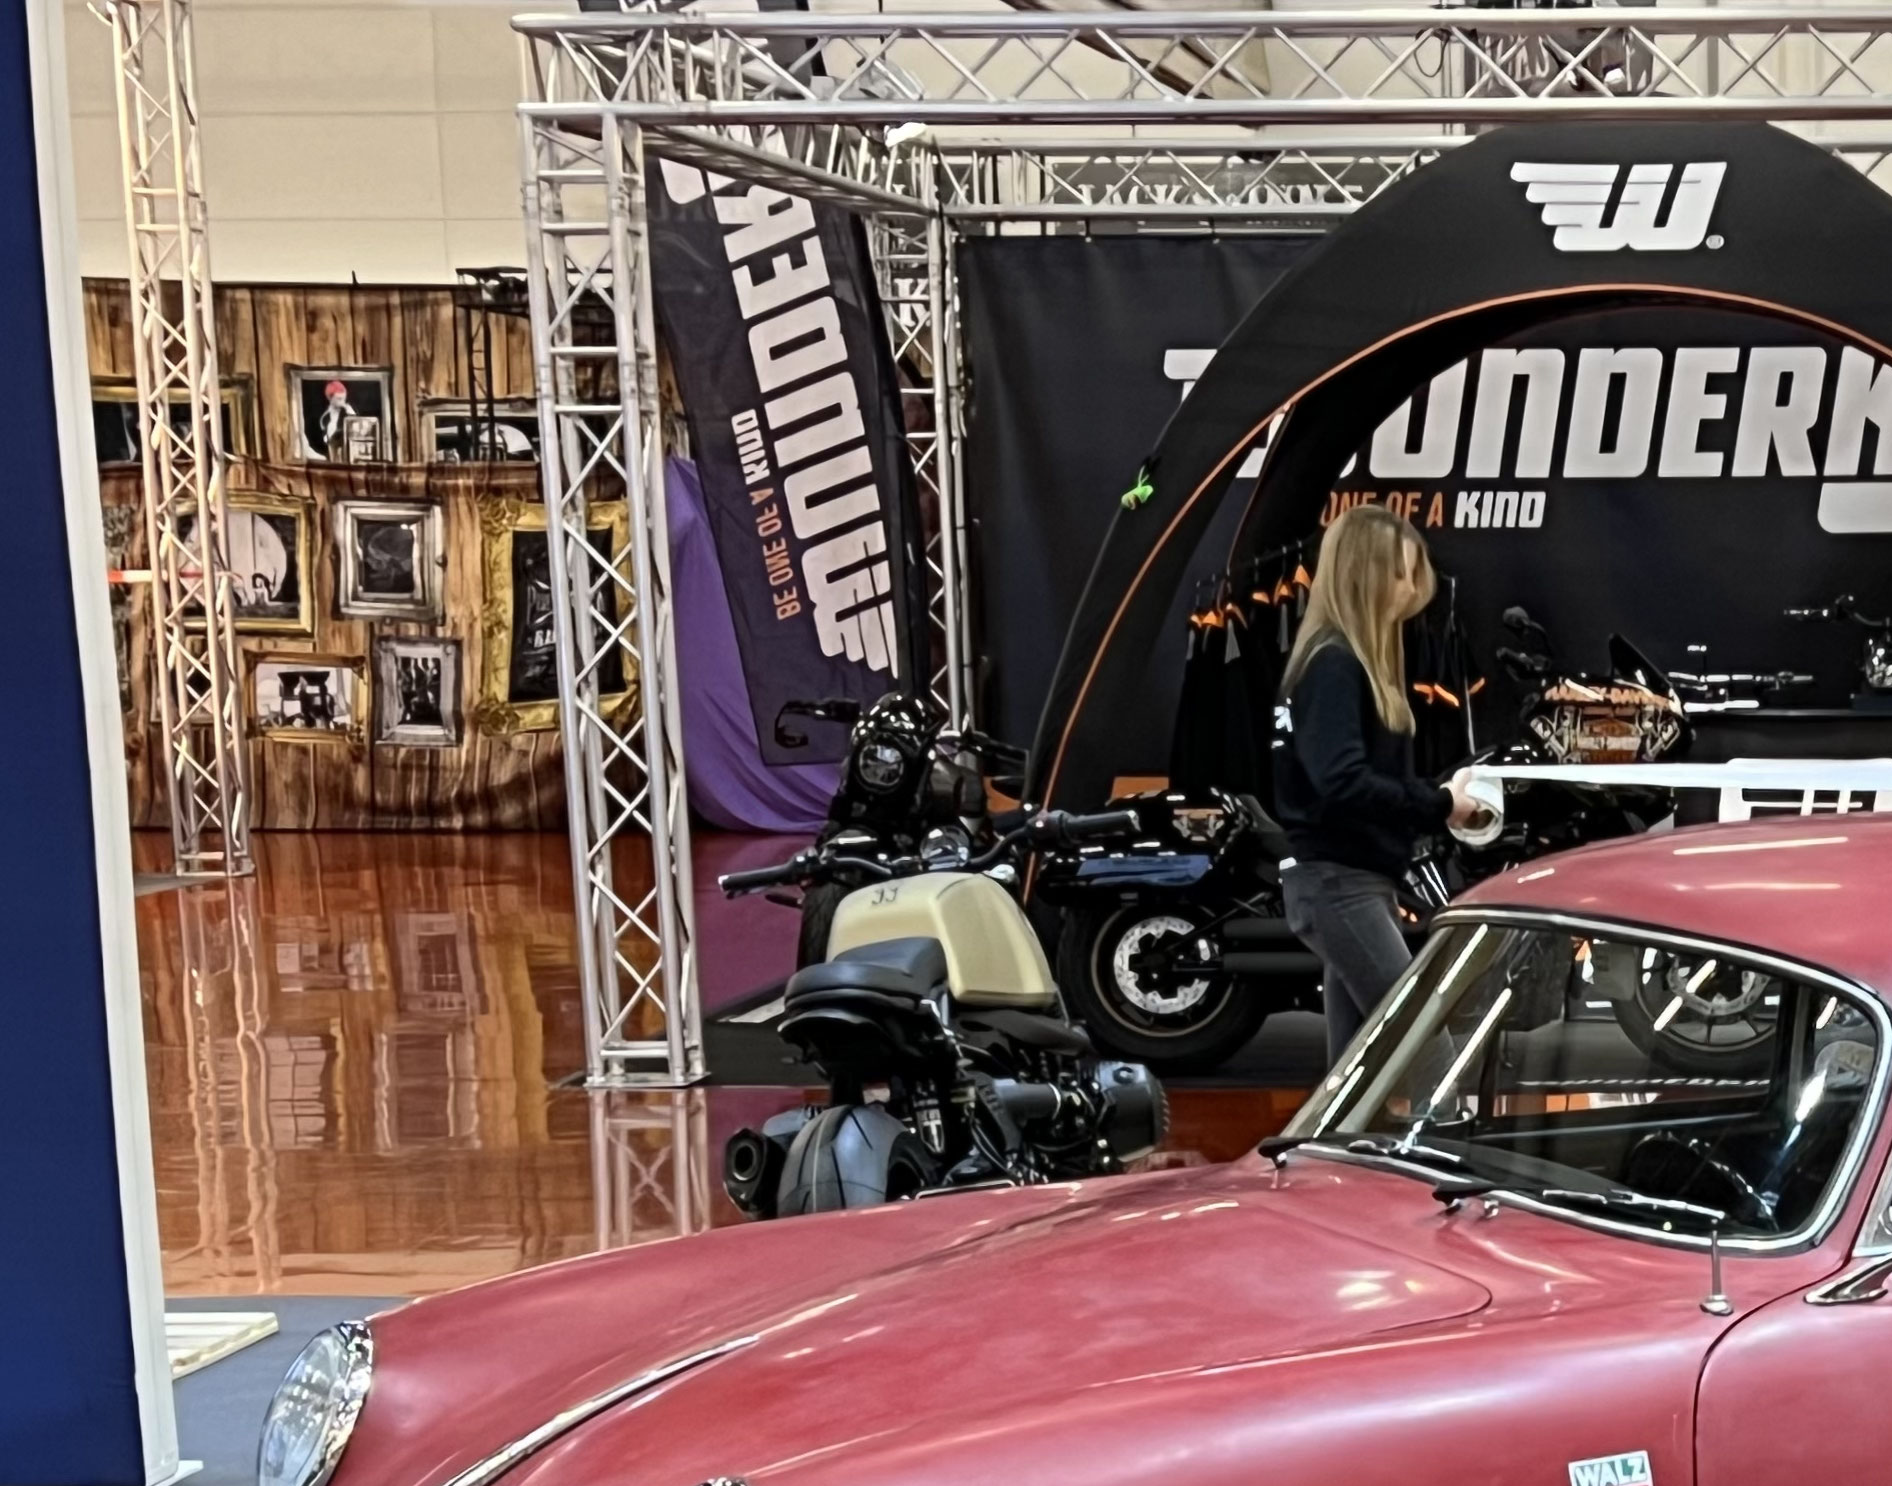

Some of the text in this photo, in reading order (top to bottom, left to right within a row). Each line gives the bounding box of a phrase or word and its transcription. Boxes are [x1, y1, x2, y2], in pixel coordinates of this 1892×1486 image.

[731, 408, 801, 621] BE ONE OF A KIND
[1426, 491, 1444, 528] A
[1454, 490, 1547, 528] KIND
